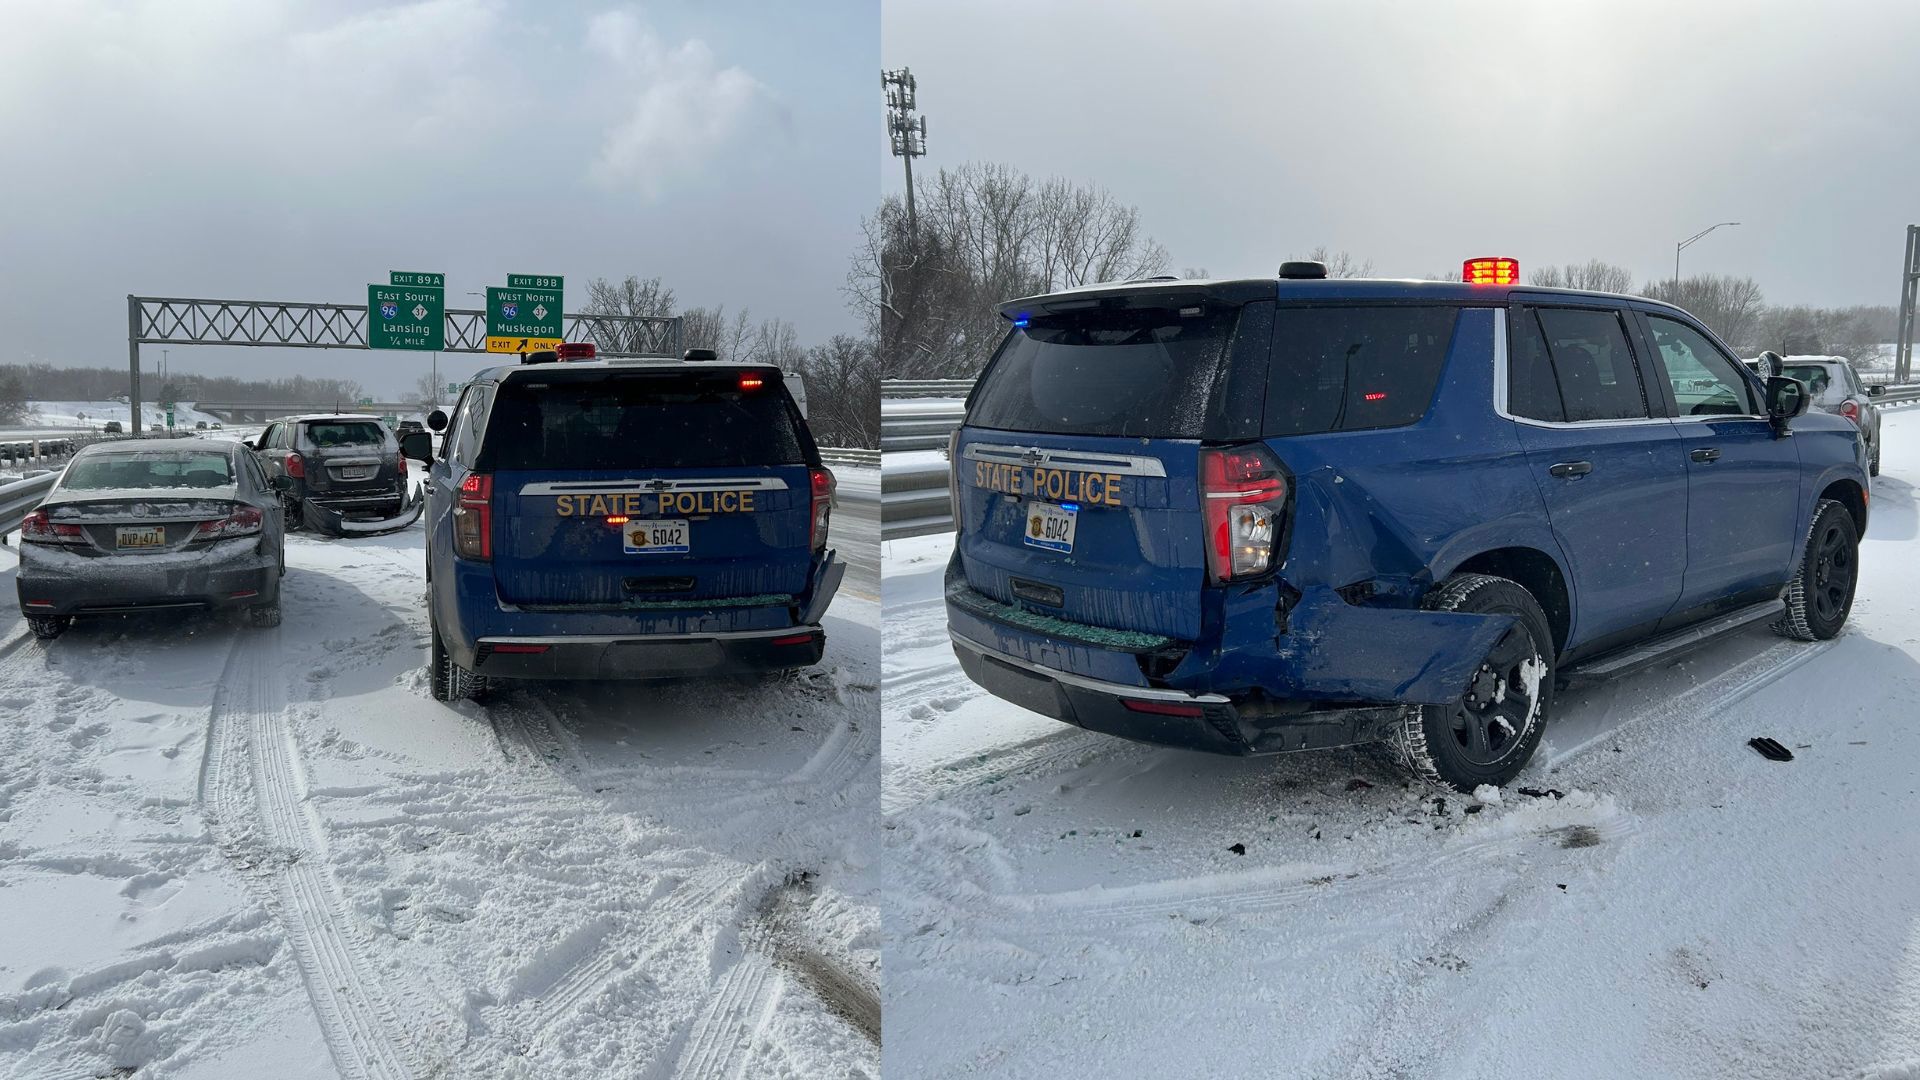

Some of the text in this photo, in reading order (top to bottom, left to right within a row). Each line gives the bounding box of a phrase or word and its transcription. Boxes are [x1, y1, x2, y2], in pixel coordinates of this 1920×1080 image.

[394, 275, 413, 283] EXIT
[514, 277, 557, 287] EXIT 89B
[382, 306, 396, 316] 96
[415, 308, 424, 316] 37
[503, 306, 516, 316] 96
[535, 308, 545, 316] 37
[383, 323, 430, 336] Lansing
[497, 323, 554, 335] Muskegon
[491, 341, 556, 350] EXIT ONLY
[976, 461, 1121, 506] STATE POLICE
[556, 491, 755, 516] STATE POLICE
[1045, 516, 1069, 542] 6042
[143, 532, 159, 544] 471
[652, 529, 682, 545] 6042
